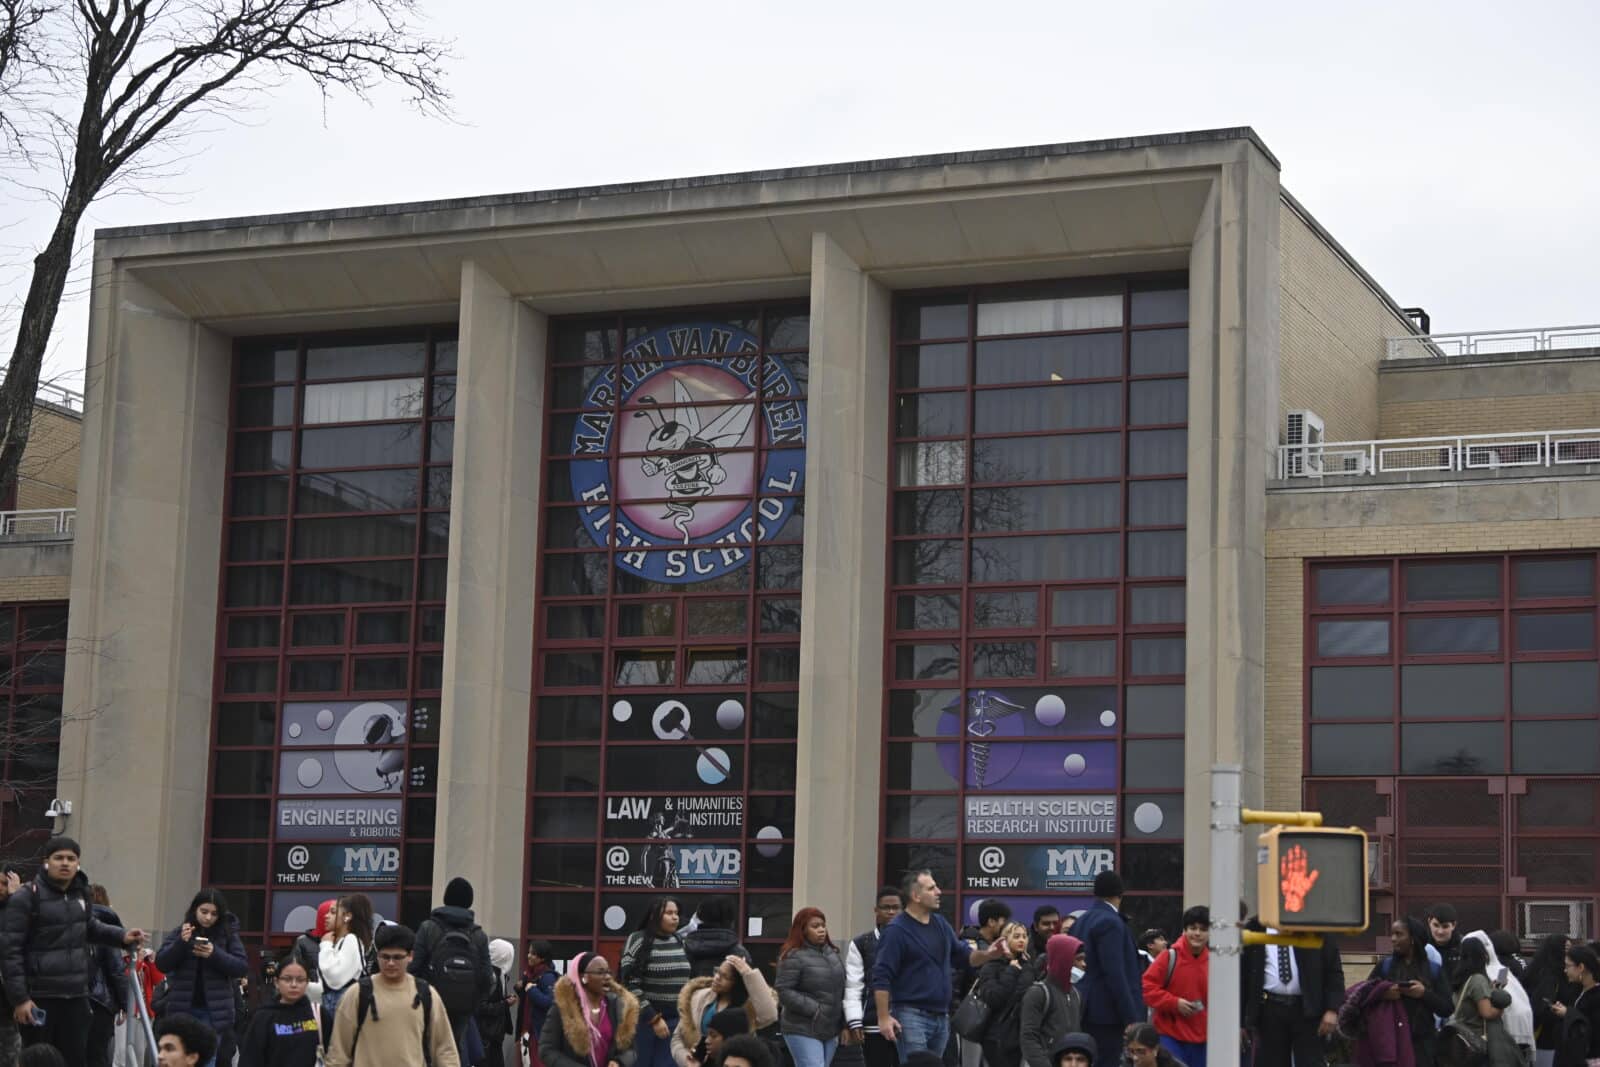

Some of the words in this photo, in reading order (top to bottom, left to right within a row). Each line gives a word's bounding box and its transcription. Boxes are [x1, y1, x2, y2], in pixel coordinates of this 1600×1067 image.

[574, 337, 664, 461] MARTIN
[667, 328, 732, 364] VAN
[728, 339, 805, 447] BUREN
[582, 483, 652, 569] HIGH
[666, 470, 797, 577] SCHOOL
[606, 797, 652, 820] LAW
[665, 797, 673, 810] &
[677, 797, 743, 810] HUMANITIES
[967, 801, 1034, 816] HEALTH
[1038, 800, 1114, 816] SCIENCE
[280, 808, 398, 826] ENGINEERING
[689, 812, 743, 826] INSTITUTE
[350, 827, 356, 837] &
[360, 826, 402, 837] ROBOTICS
[967, 819, 1039, 833] RESEARCH
[1045, 819, 1115, 833] INSTITUTE
[287, 845, 309, 870] @
[343, 847, 400, 872] MVB
[606, 846, 630, 871] @
[679, 848, 741, 874] MVB
[979, 846, 1005, 873] @
[277, 873, 295, 883] THE
[298, 873, 320, 882] NEW
[606, 875, 625, 885] THE
[628, 875, 653, 885] NEW
[967, 877, 989, 887] THE
[992, 877, 1019, 887] NEW
